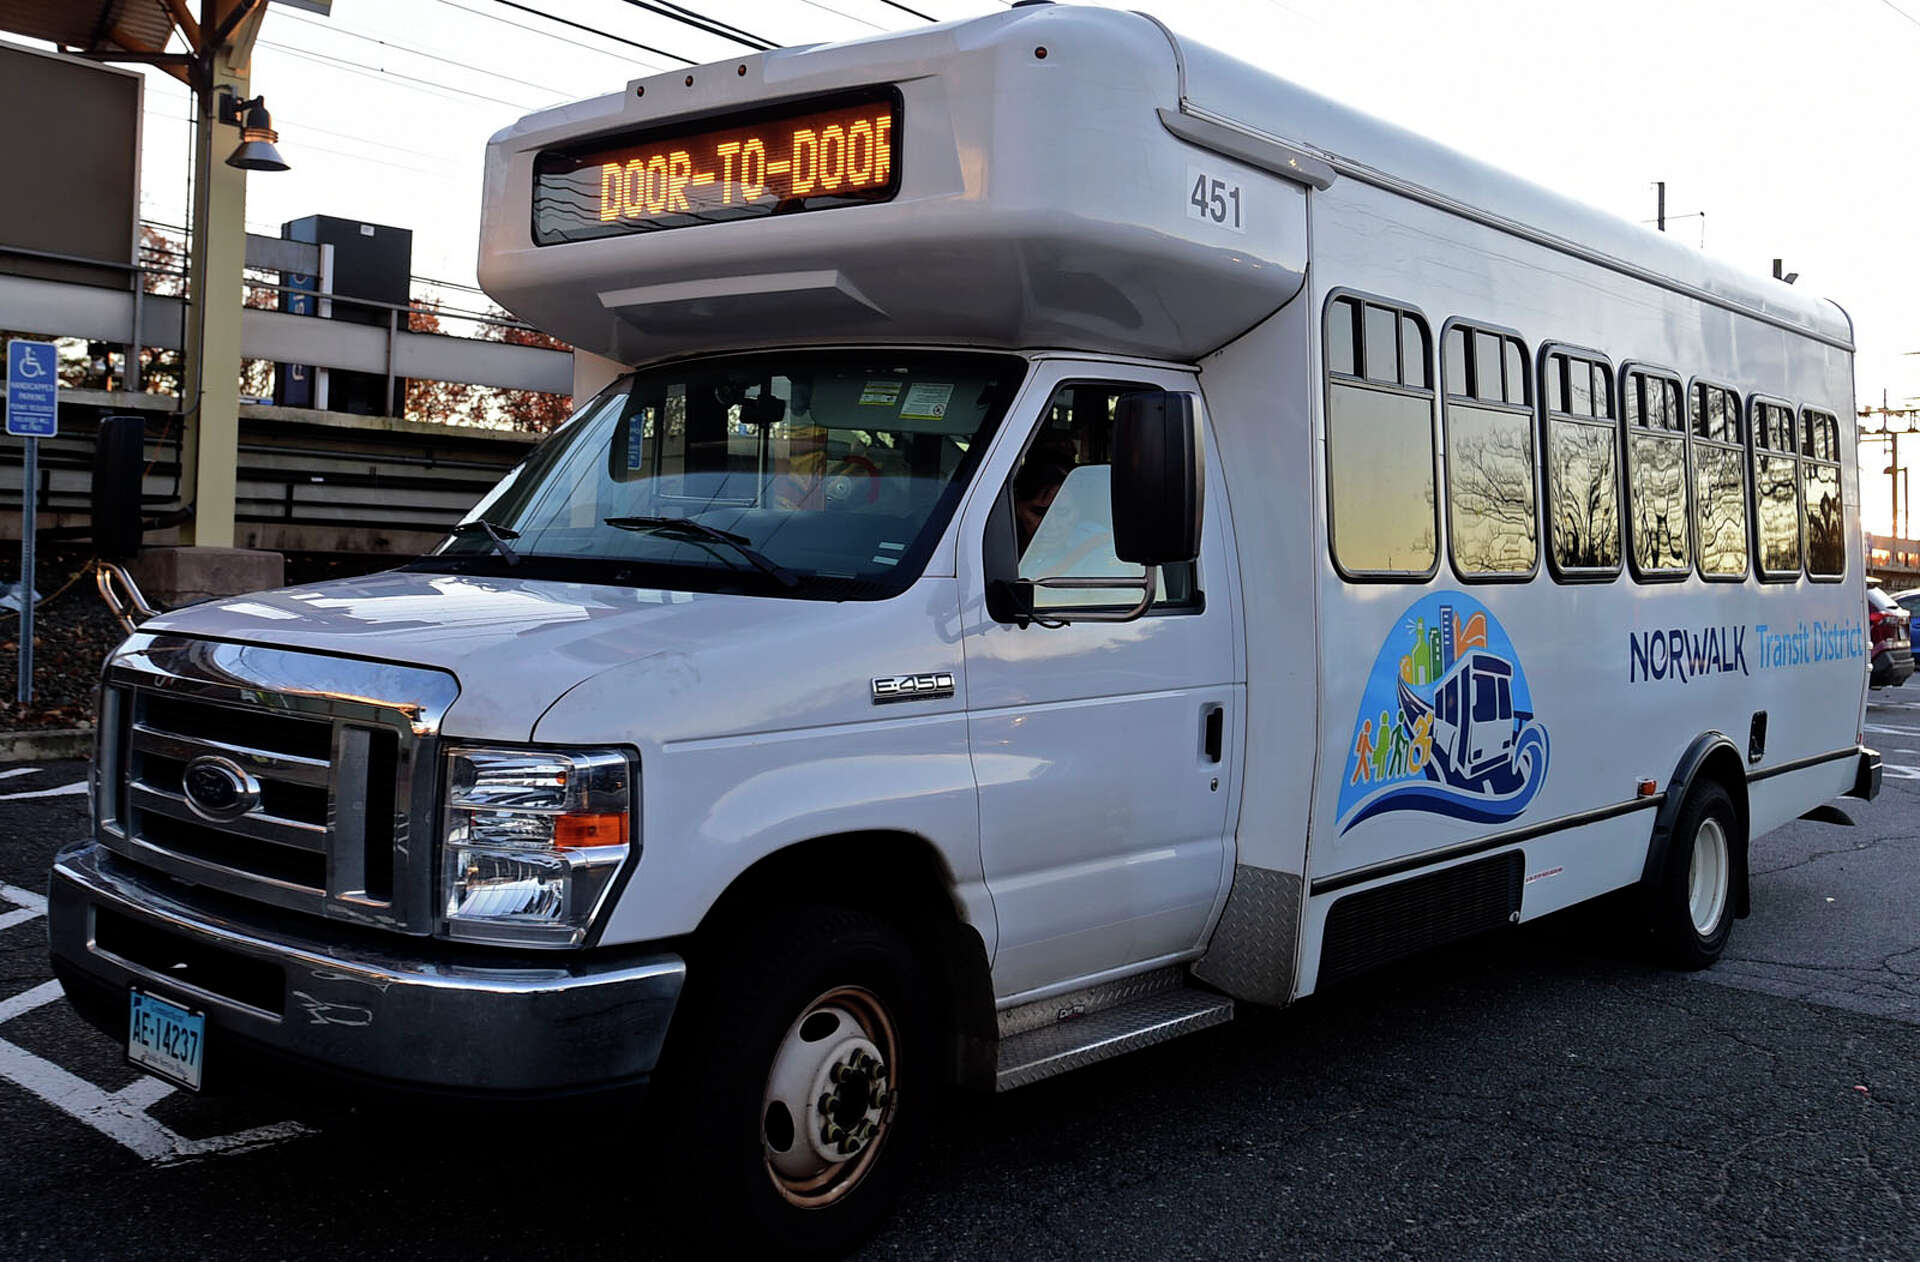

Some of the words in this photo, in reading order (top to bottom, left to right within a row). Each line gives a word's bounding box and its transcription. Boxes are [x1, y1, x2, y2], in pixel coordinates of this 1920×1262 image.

[1191, 174, 1240, 228] 451
[1630, 624, 1749, 684] NORWALK
[1755, 621, 1810, 669] Transit
[1813, 618, 1864, 662] District
